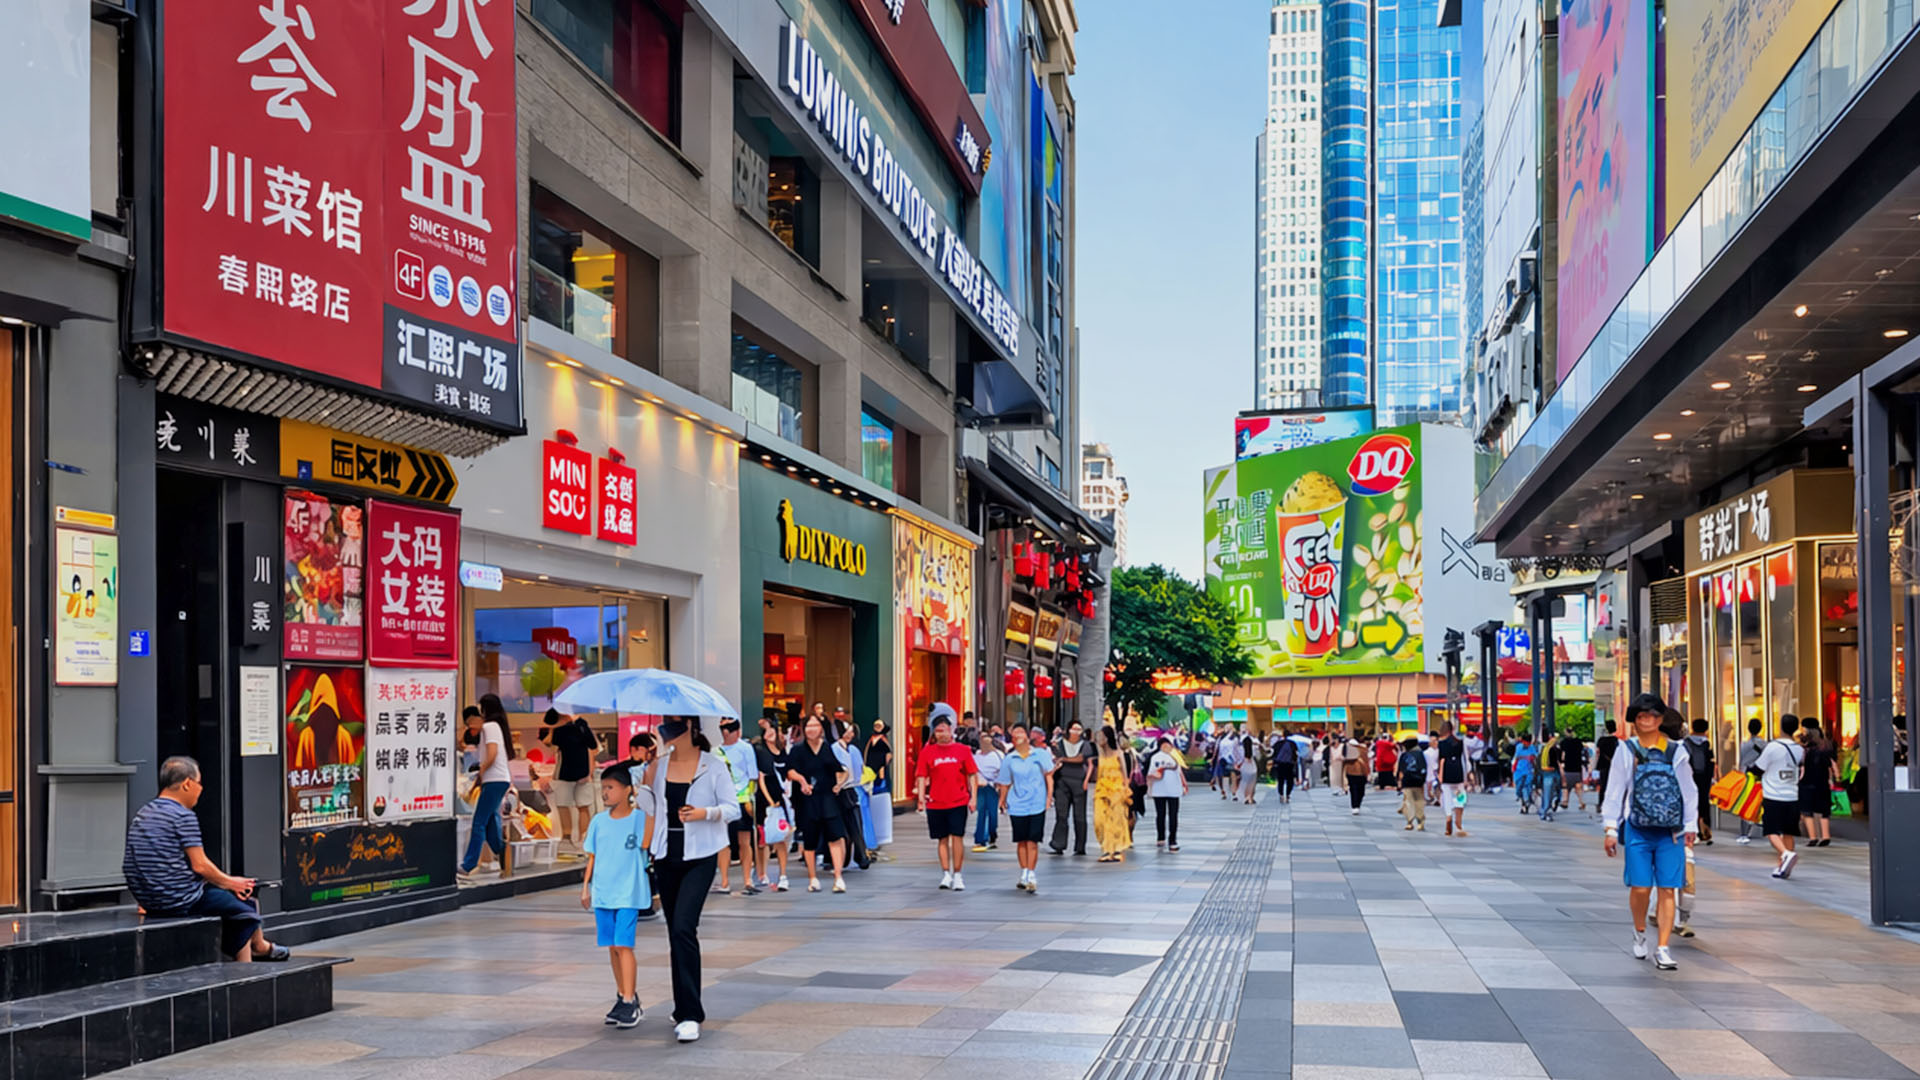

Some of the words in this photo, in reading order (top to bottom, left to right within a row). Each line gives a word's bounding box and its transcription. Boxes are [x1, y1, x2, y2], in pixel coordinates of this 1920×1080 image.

[203, 145, 363, 254] 川菜馆
[409, 213, 449, 241] SINCE
[399, 262, 421, 289] 4F
[549, 455, 587, 489] MIN
[1357, 446, 1405, 481] DQ
[381, 521, 443, 570] 大码
[381, 569, 446, 619] 女装
